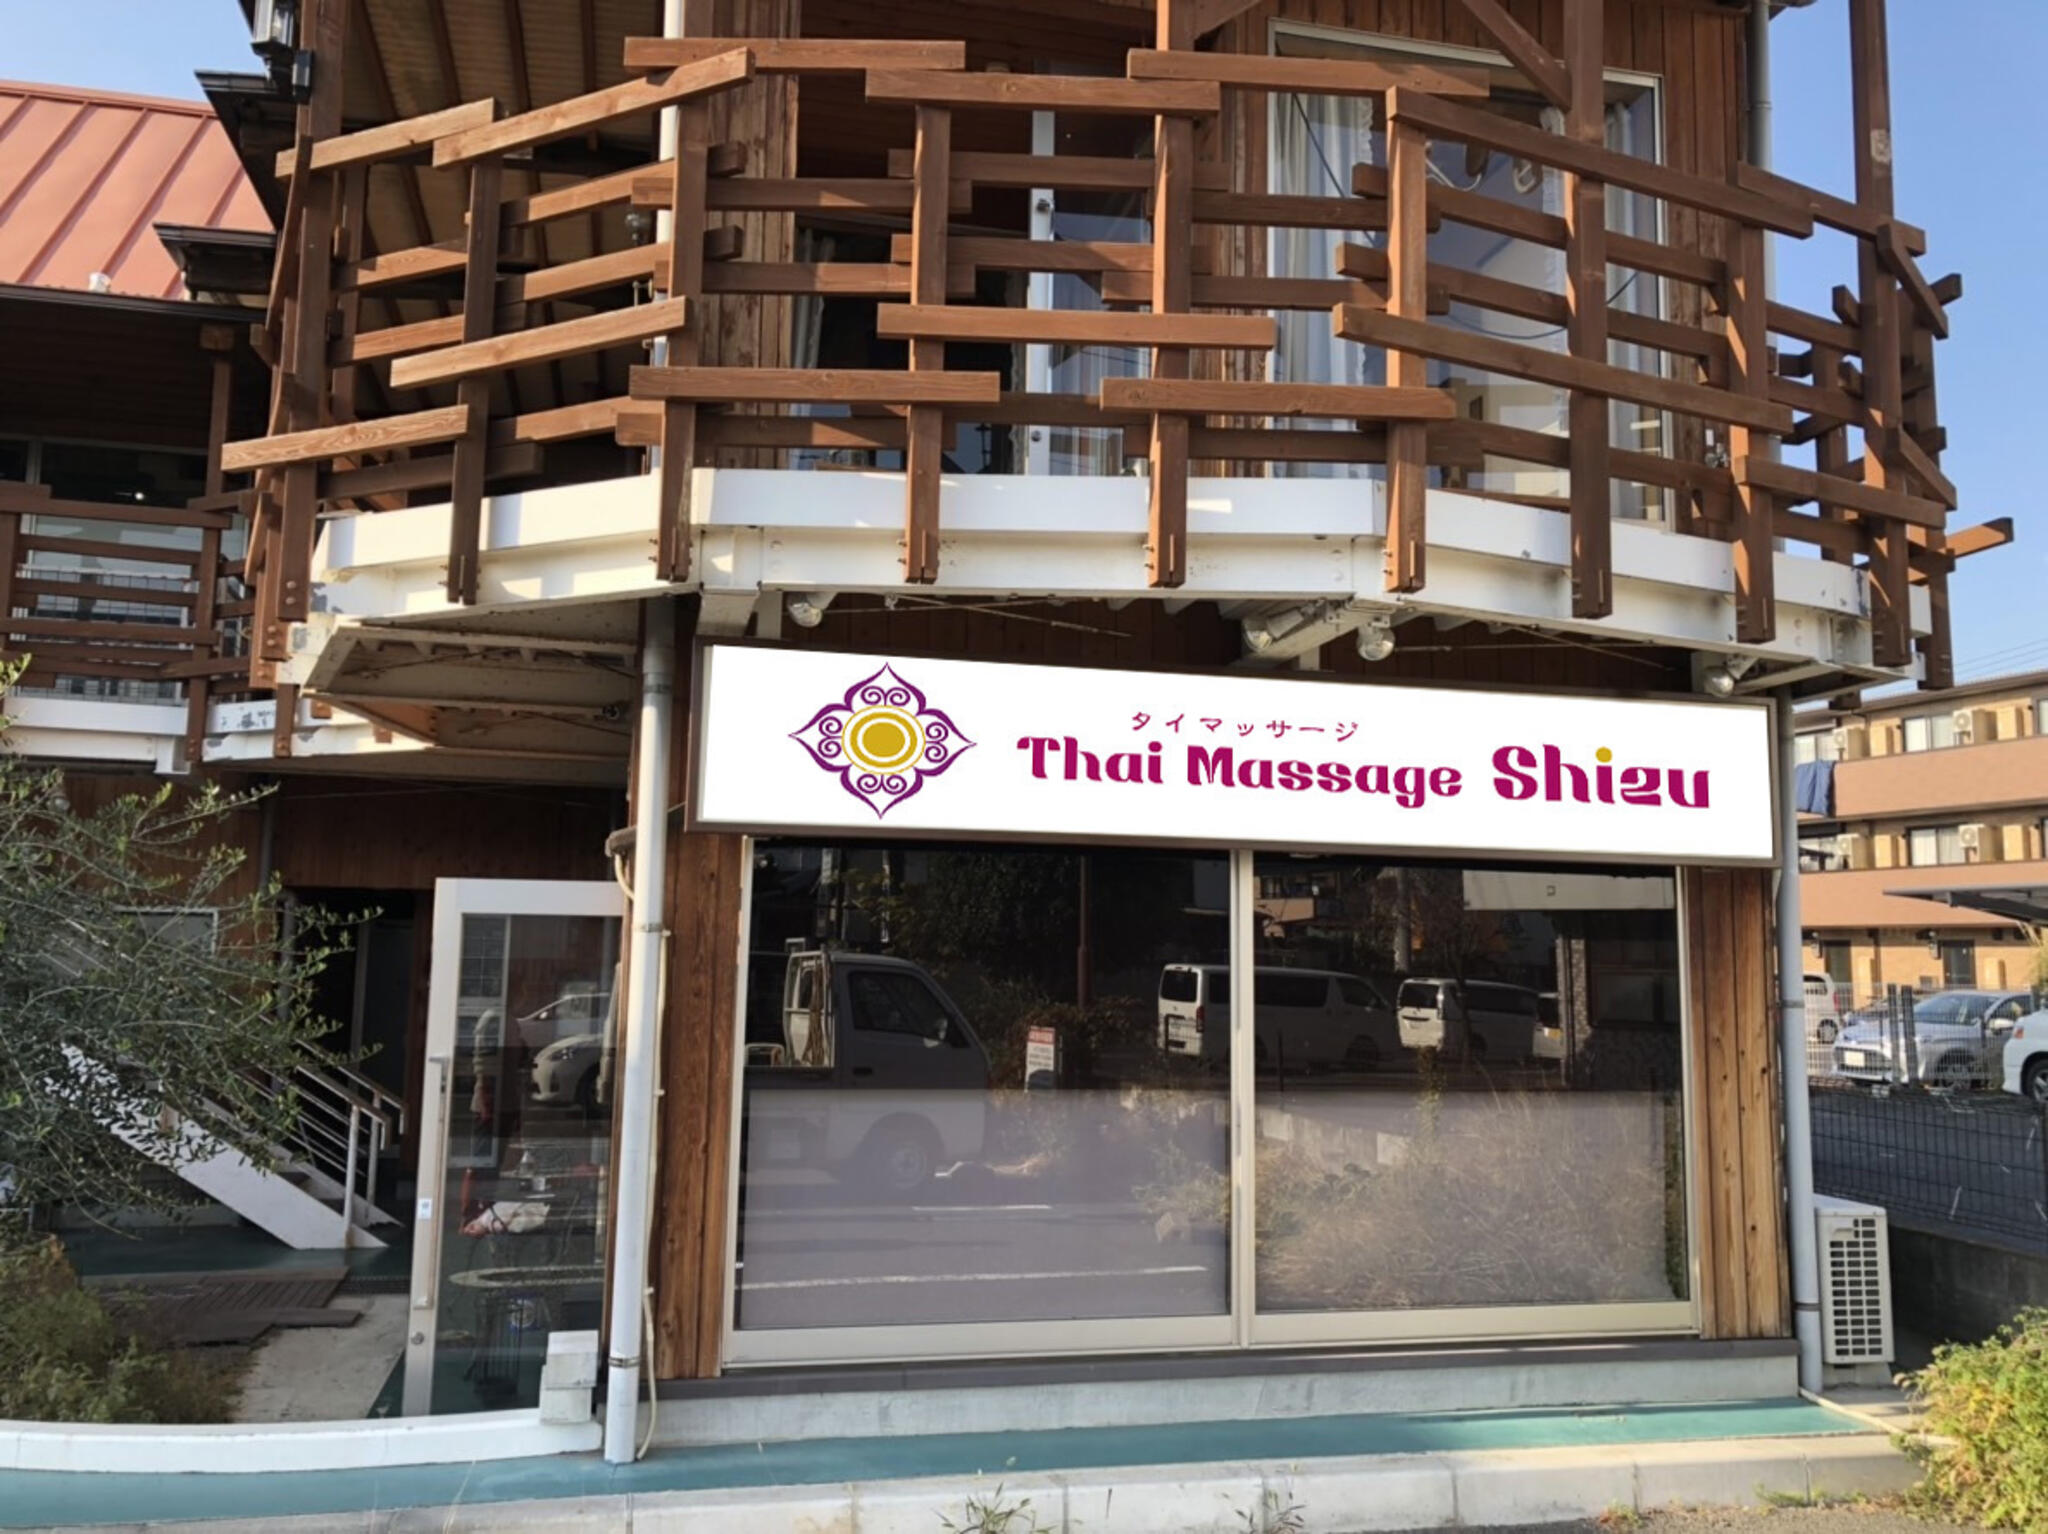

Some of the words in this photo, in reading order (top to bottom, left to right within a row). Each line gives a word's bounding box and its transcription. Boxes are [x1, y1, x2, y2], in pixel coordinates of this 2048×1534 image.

[1132, 711, 1359, 743] タイマッサージ
[1016, 736, 1164, 784] Thai
[1187, 745, 1463, 809] Massage
[1491, 744, 1710, 809] Shizu
